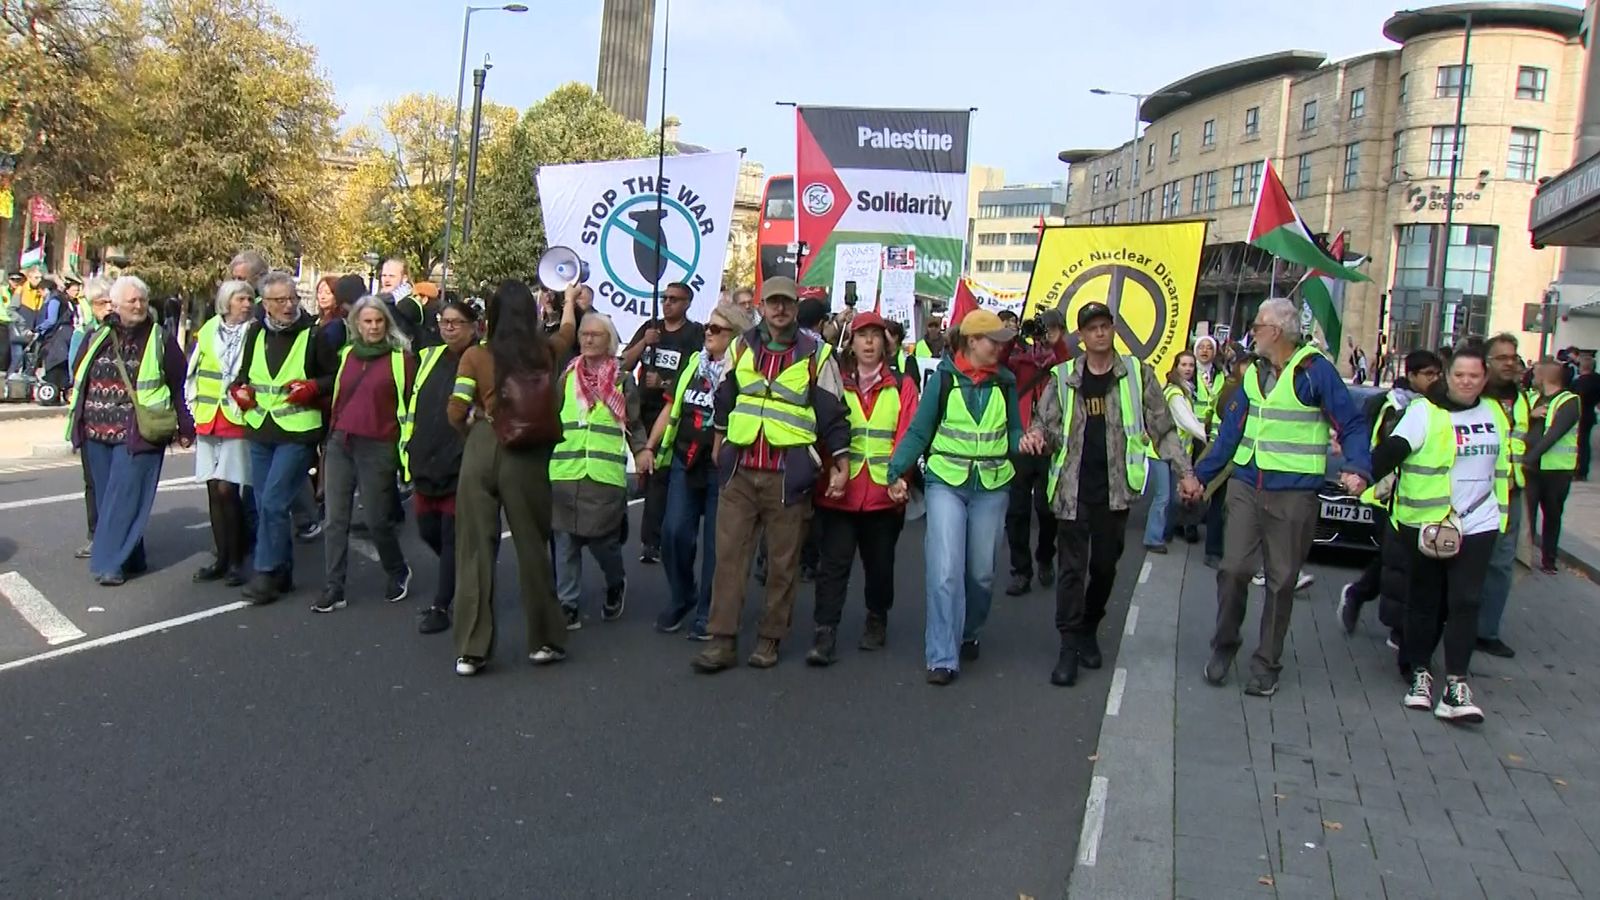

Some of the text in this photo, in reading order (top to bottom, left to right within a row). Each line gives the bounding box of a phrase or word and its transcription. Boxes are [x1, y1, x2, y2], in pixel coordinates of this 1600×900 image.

[857, 126, 953, 152] Palestine
[581, 175, 715, 246] STOP THE WAR
[809, 194, 829, 205] PSC
[856, 190, 952, 221] Solidarity
[1062, 247, 1180, 366] for Nuclear Disarmamen
[655, 352, 678, 367] ESS
